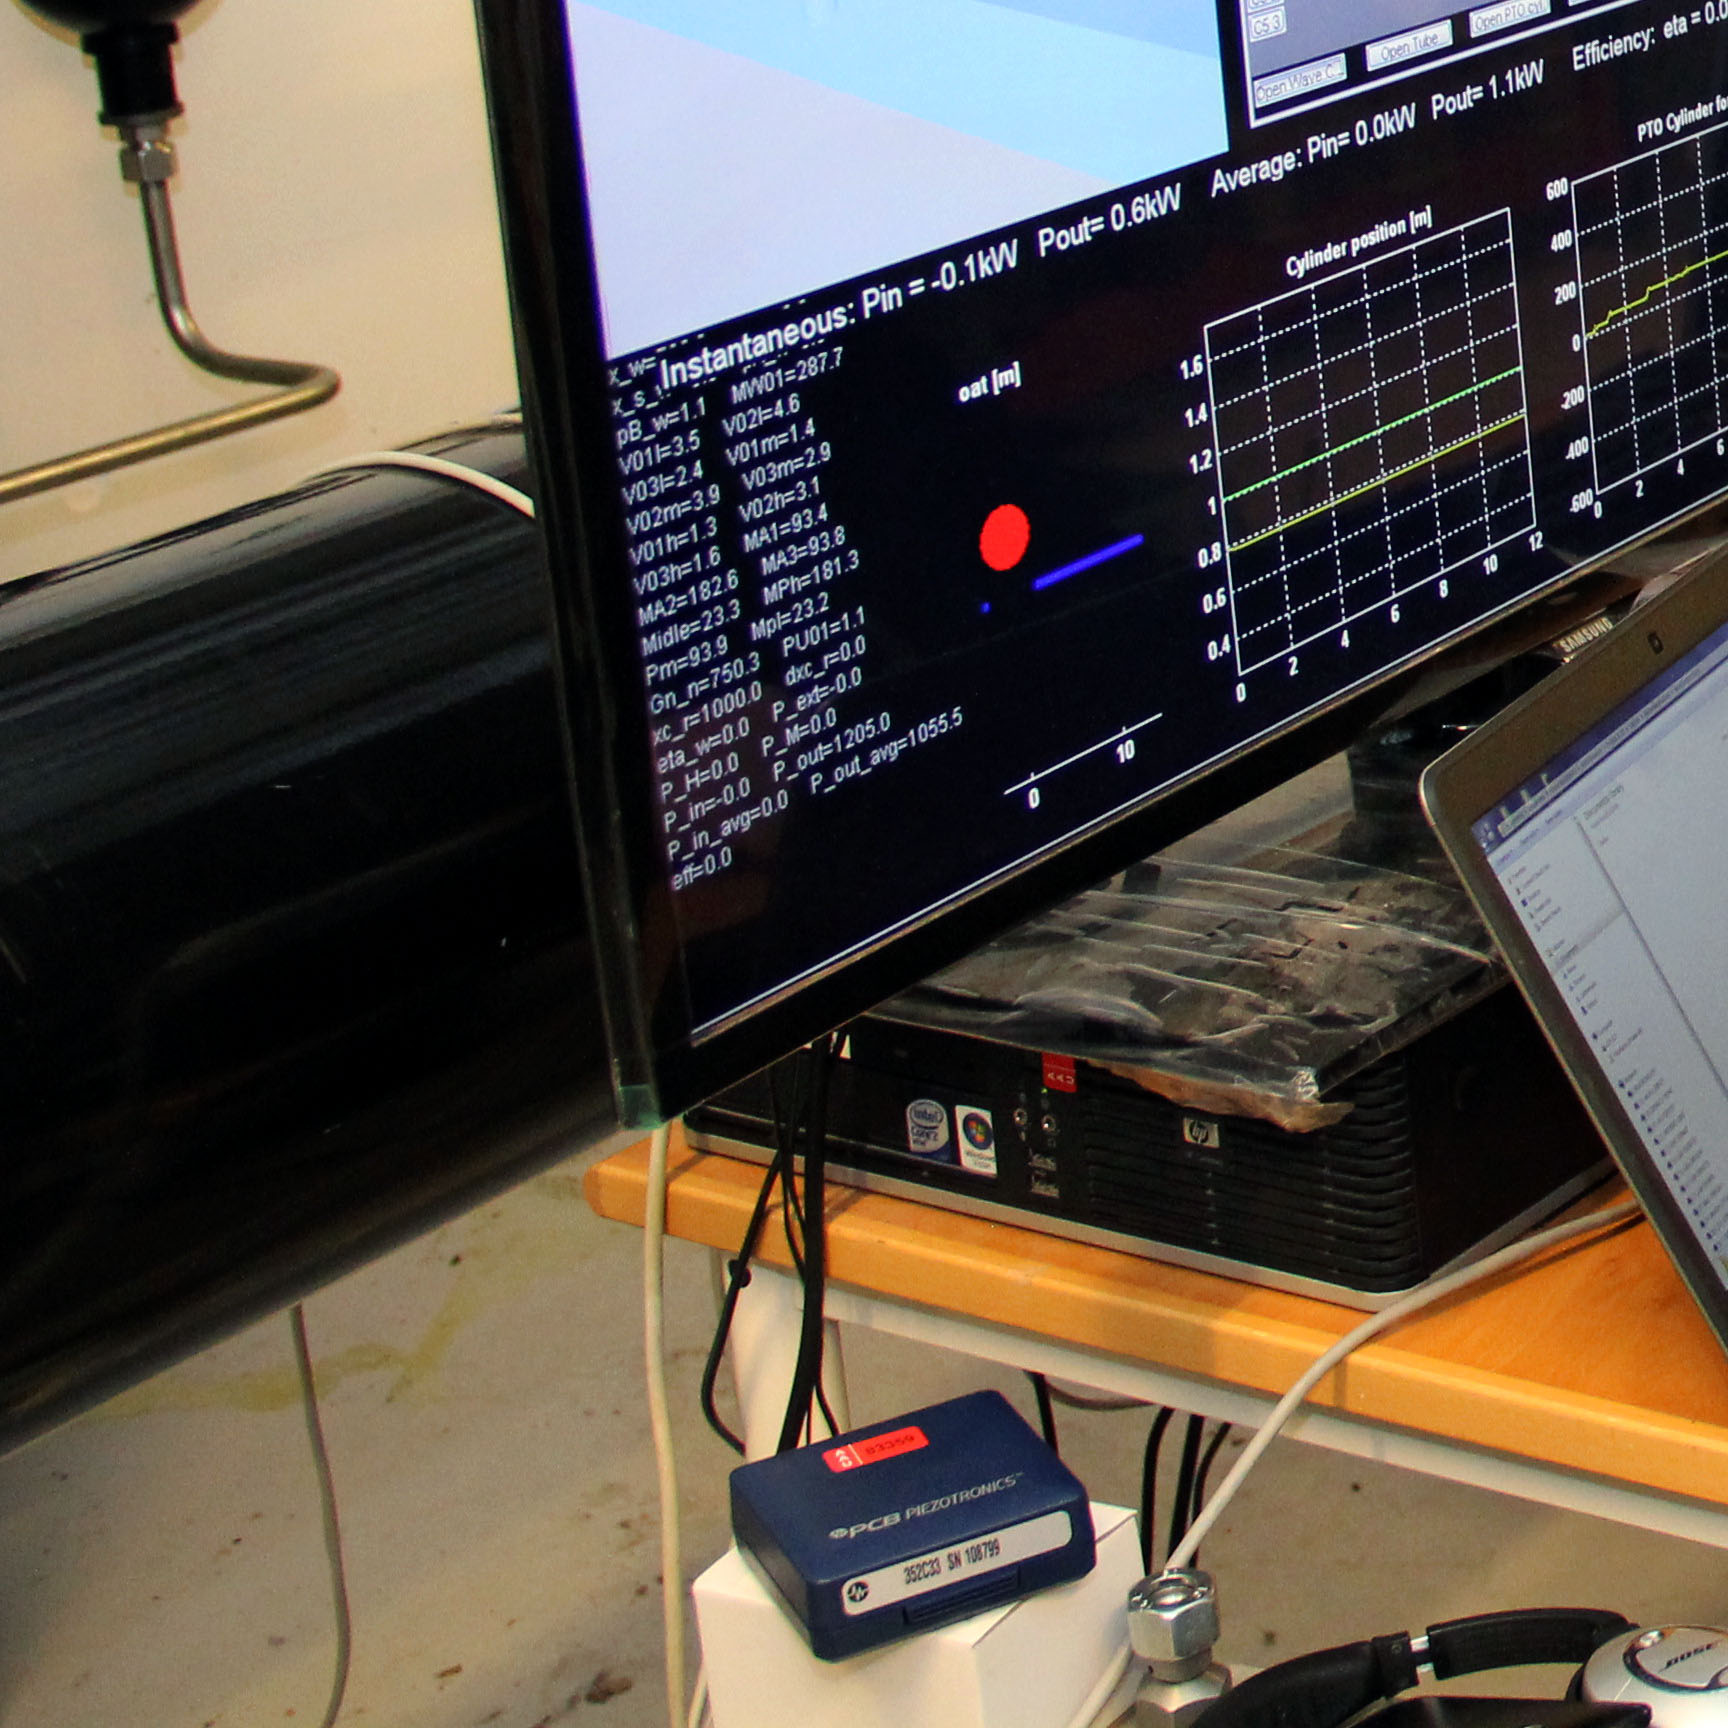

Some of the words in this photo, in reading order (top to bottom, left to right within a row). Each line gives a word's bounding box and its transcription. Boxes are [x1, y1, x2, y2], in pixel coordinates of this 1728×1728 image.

[1253, 18, 1270, 35] C5
[1573, 27, 1656, 72] Efficiency:
[1663, 16, 1687, 40] eta
[1705, 1, 1728, 24] 0.0
[1380, 41, 1409, 62] Open
[1412, 32, 1440, 52] Tube
[1212, 148, 1302, 198] Average:
[1307, 130, 1350, 165] Pin=
[1355, 103, 1415, 148] 0.0kW
[1431, 83, 1484, 121] Pout=
[1490, 60, 1544, 99] 1.1kW
[1638, 118, 1663, 142] PTO
[1666, 102, 1713, 134] Cylinder
[1546, 178, 1569, 201] 600
[1285, 238, 1347, 278] Cylinder
[1351, 219, 1406, 253] position
[1410, 206, 1432, 234] [m]
[1550, 229, 1572, 252] 400
[661, 303, 856, 390] Instantaneous:
[862, 281, 902, 319] Pin
[930, 239, 1018, 292] -0.1kW
[1037, 216, 1105, 257] Pout=
[1110, 183, 1182, 233] 0.6kW
[1555, 281, 1576, 305] 200
[1573, 334, 1580, 352] 0
[731, 346, 843, 405] MW01=287.7
[992, 361, 1021, 395] [m]
[1180, 355, 1203, 380] 1.6
[1184, 403, 1208, 428] 1.4
[725, 417, 815, 466] V01m=1.4
[1717, 438, 1724, 456] 6
[1189, 449, 1213, 474] 1.2
[1677, 459, 1684, 476] 4
[626, 483, 720, 536] V02m=3.9
[741, 442, 831, 491] V03m=2.9
[1636, 480, 1643, 498] 2
[1208, 497, 1217, 515] 1
[1594, 501, 1602, 518] 0
[629, 516, 718, 566] V01h=1.3
[739, 475, 819, 522] V02h=3.1
[634, 545, 721, 596] V03h=1.6
[743, 502, 828, 553] MA1=93.4
[1529, 531, 1543, 552] 12
[1198, 543, 1222, 568] 0.8
[1483, 553, 1499, 575] 10
[638, 569, 739, 627] MA2=182.6
[761, 525, 845, 575] MA3=93.8
[764, 549, 860, 605] MPh=181.3
[1439, 579, 1448, 598] 8
[1203, 588, 1226, 614] 0.6
[1391, 604, 1400, 623] 6
[783, 606, 865, 658] PU01=1.1
[1341, 630, 1350, 649] 4
[1560, 617, 1613, 652] SAMSUNG
[645, 635, 728, 685] Pm=93.9
[784, 634, 867, 687] dxc_r=0.0
[1208, 635, 1231, 662] 0.4
[1288, 656, 1298, 676] 2
[1236, 682, 1246, 702] 0
[657, 716, 750, 773] eta_w=0.0
[660, 752, 739, 805] P_H=0.0
[761, 707, 837, 757] P_M=0.0
[773, 712, 891, 782] P_out=1205.0
[1117, 739, 1135, 764] 10
[667, 789, 789, 862] P_in_avg=0.0
[810, 706, 963, 795] P_out_avg=1055.5
[1028, 787, 1040, 809] 0
[671, 846, 733, 891] eff=0.0
[850, 1512, 901, 1539] PCB
[947, 1551, 961, 1570] SN
